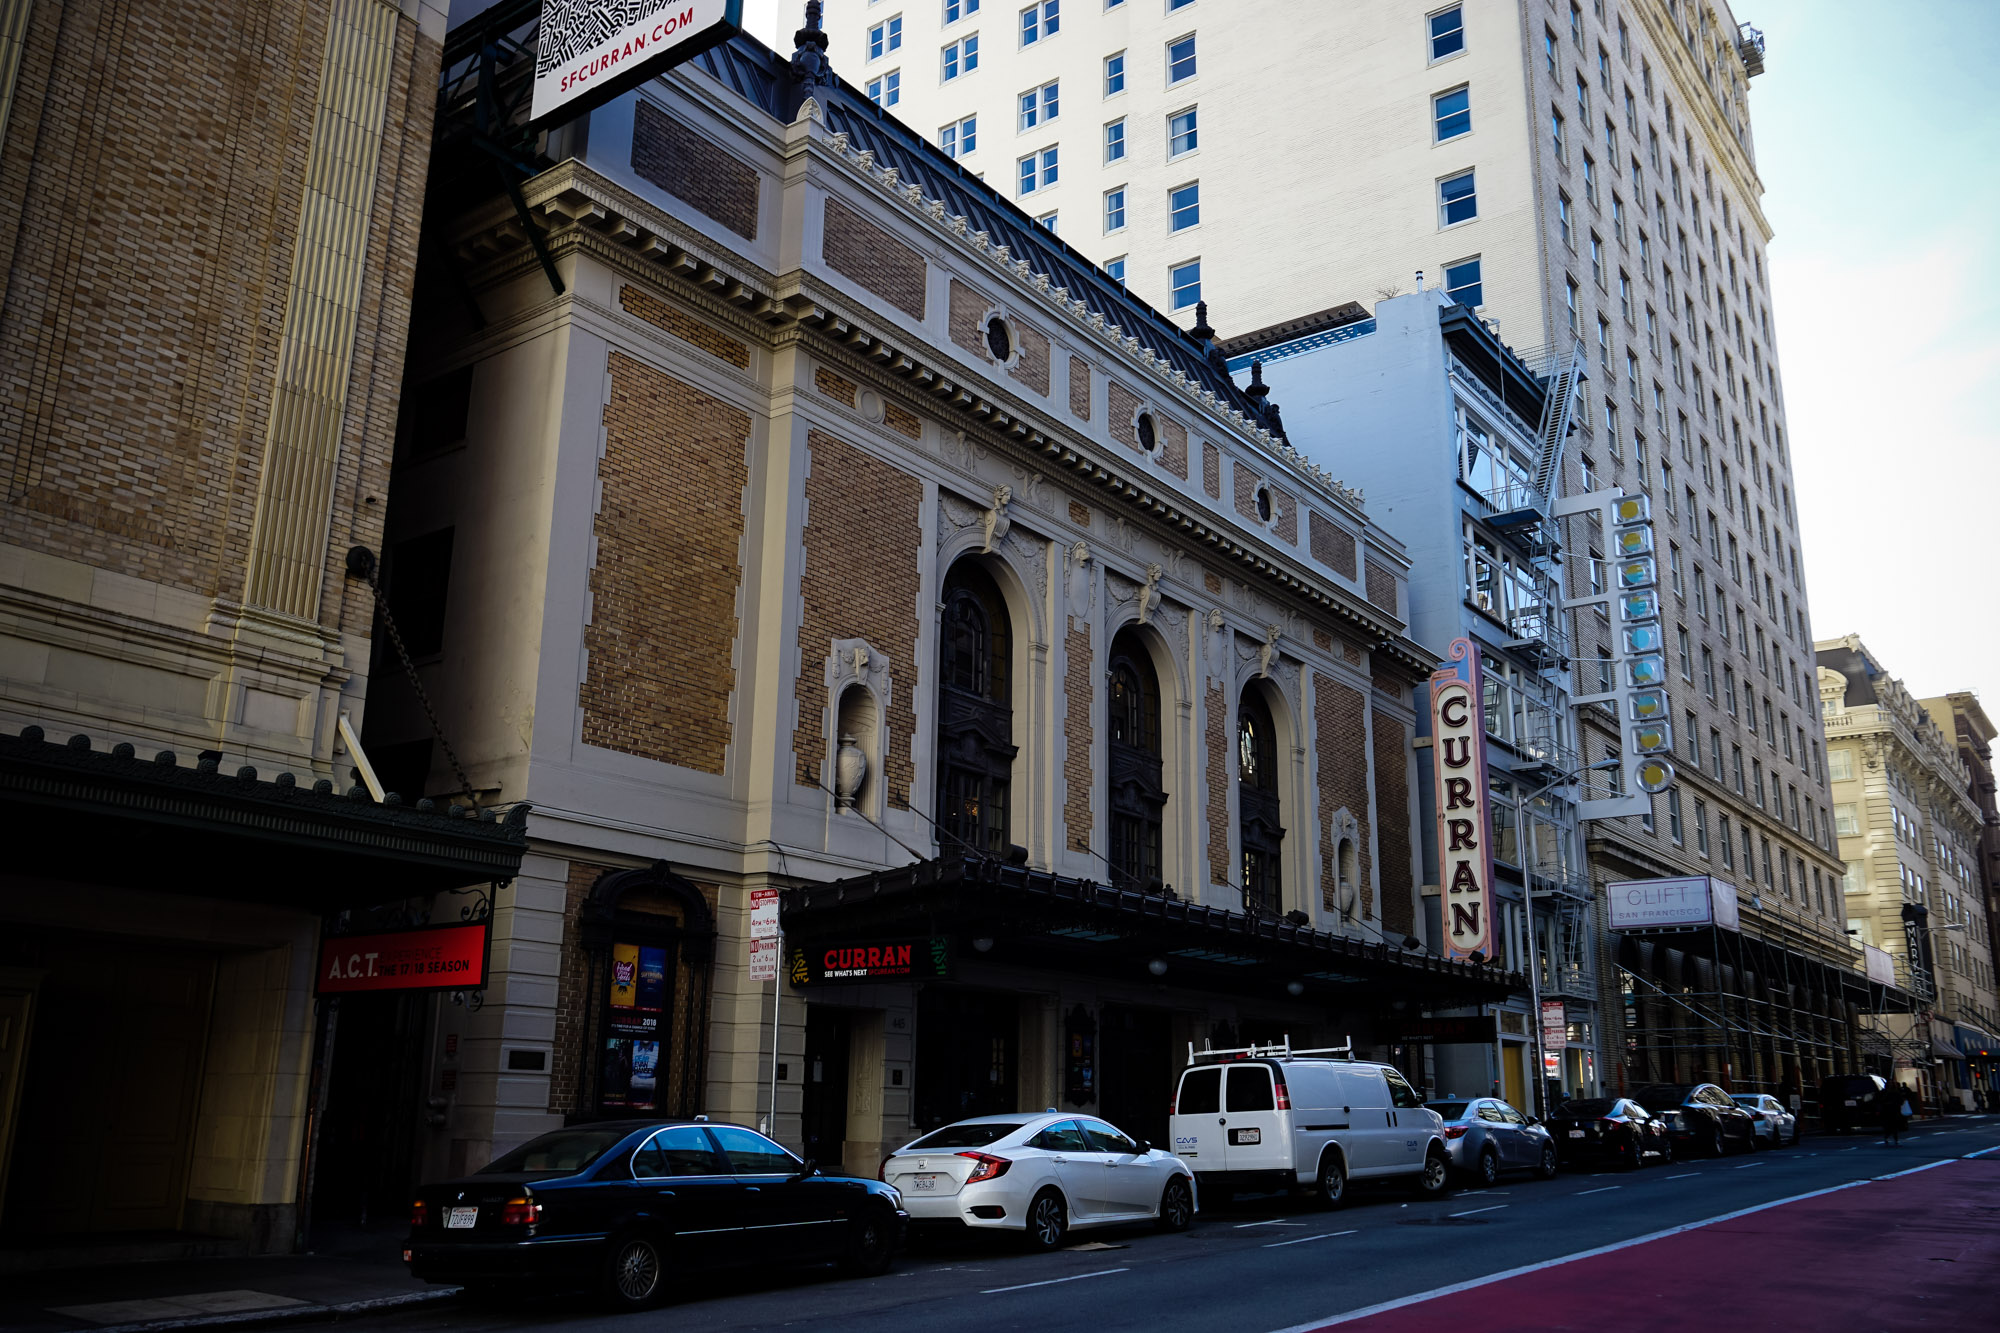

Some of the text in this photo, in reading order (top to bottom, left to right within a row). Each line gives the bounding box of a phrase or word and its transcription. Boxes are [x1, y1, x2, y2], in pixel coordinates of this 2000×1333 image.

[560, 7, 694, 92] SFCURRAN.COM
[1441, 696, 1480, 936] CURRAN
[751, 898, 777, 909] NO STOPPING
[1627, 886, 1688, 906] CLIFT
[1619, 908, 1701, 920] SAN FRANCISCO
[751, 941, 776, 952] NO PARKING
[327, 952, 379, 979] A.C.T.
[824, 945, 912, 970] CURRAN
[379, 963, 396, 977] THE
[427, 959, 470, 974] SEASON
[824, 970, 834, 978] SEE
[834, 969, 853, 977] WHAT'S
[853, 968, 868, 977] NEXT
[642, 1018, 657, 1027] 2018
